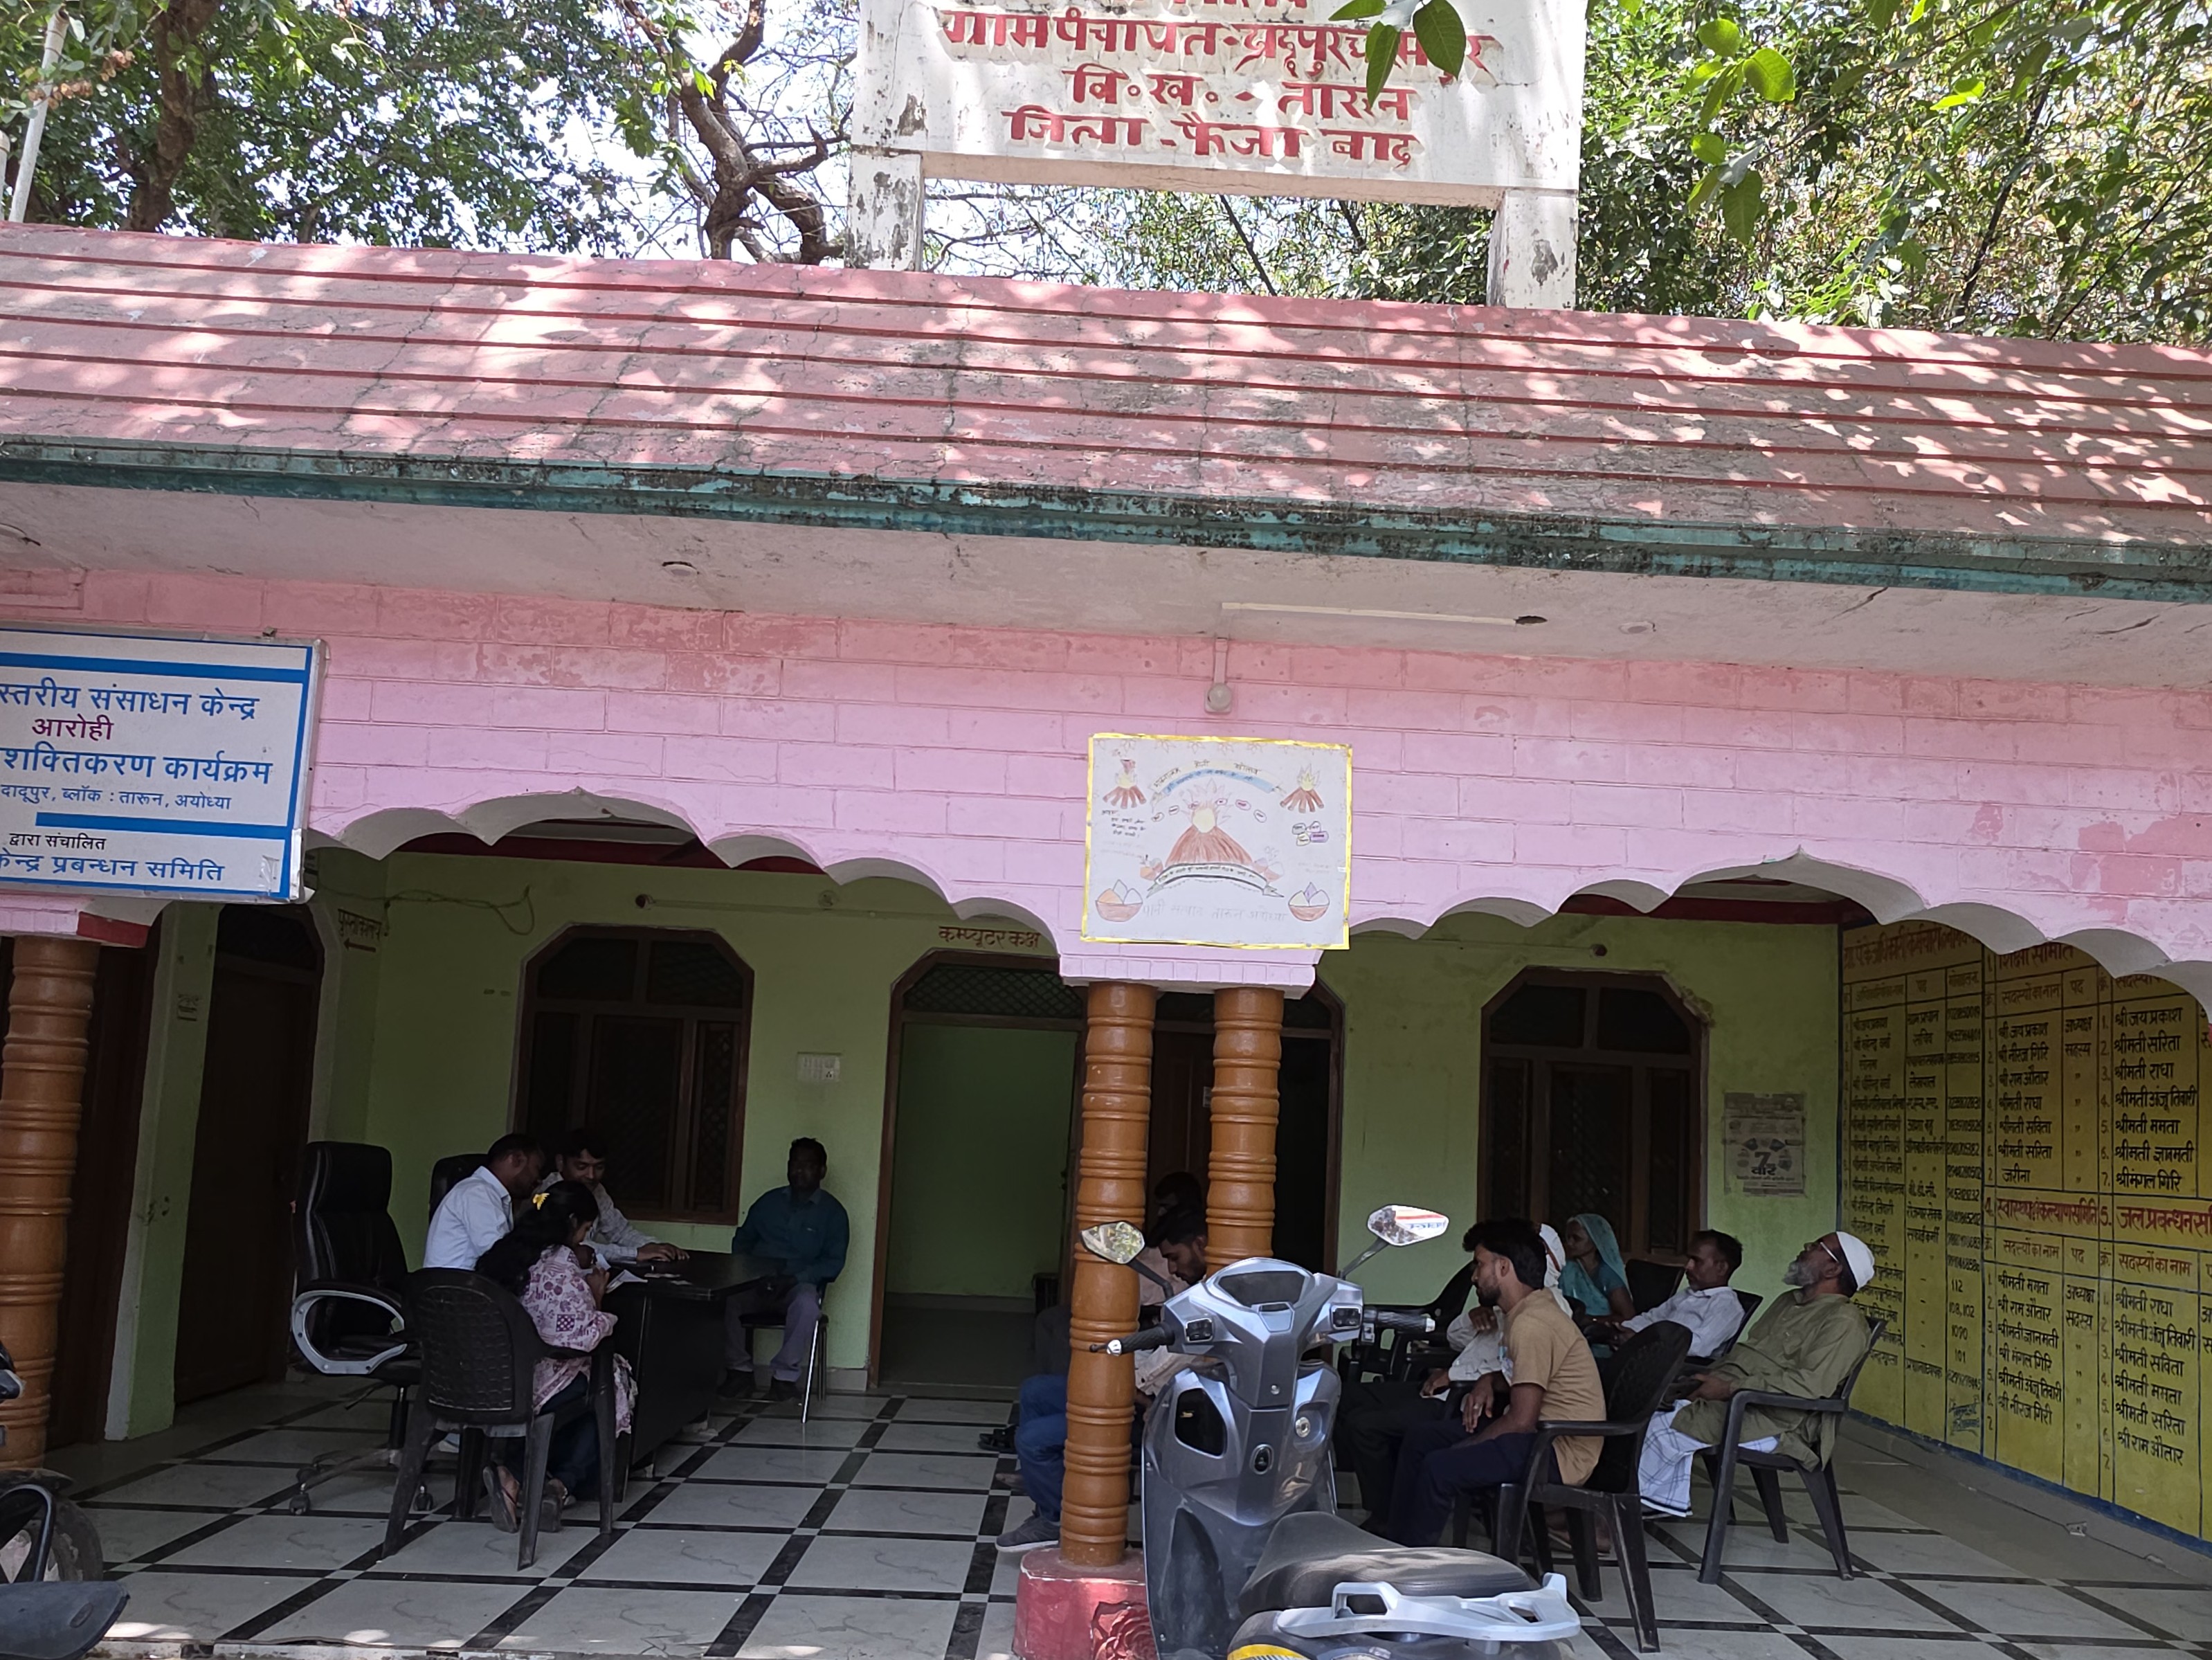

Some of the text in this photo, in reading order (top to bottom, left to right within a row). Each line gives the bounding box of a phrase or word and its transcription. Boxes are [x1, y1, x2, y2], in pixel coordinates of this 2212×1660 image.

[89, 683, 192, 714] संसाधन
[199, 687, 260, 720] केन्द्र
[32, 714, 114, 741] आरोही
[163, 750, 273, 784] कार्यक्रम
[62, 786, 102, 802] ब्लॉक
[175, 794, 232, 811] अयोध्या
[9, 832, 107, 851] द्वारा संचालित
[51, 856, 138, 876] प्रबन्धन
[145, 858, 225, 881] समिति
[2069, 980, 2085, 995] पद
[2114, 1030, 2146, 1054] श्रीमती
[2147, 1029, 2181, 1054] सरिता
[2114, 1056, 2175, 1081] श्रीमती राधा
[2115, 1085, 2147, 1108] श्रीमती
[2169, 1085, 2198, 1108] तिवारी
[2115, 1112, 2181, 1135] श्रीमती ममता
[2115, 1138, 2150, 1162] श्रीमती
[2002, 1162, 2031, 1184] जरीना
[2157, 1169, 2182, 1192] गिरि
[2071, 1247, 2085, 1265] पद
[2118, 1250, 2154, 1274] सदस्यों
[2169, 1259, 2193, 1276] नाम
[1951, 1279, 1963, 1293] 112
[1997, 1270, 2024, 1292] श्रीमती
[1997, 1294, 2009, 1314] श्री
[2115, 1287, 2173, 1318] श्रीमती राधा
[2115, 1314, 2147, 1341] श्रीमती
[2167, 1324, 2195, 1351] तिवारी
[1954, 1348, 1966, 1364] 101
[1999, 1342, 2010, 1363] श्री
[2115, 1342, 2184, 1378] श्रीमती सविता
[2115, 1369, 2182, 1407] श्रीमती ममता
[2115, 1398, 2186, 1436] श्रीमती सरिता
[2118, 1427, 2130, 1450] श्री
[2132, 1435, 2149, 1455] राम
